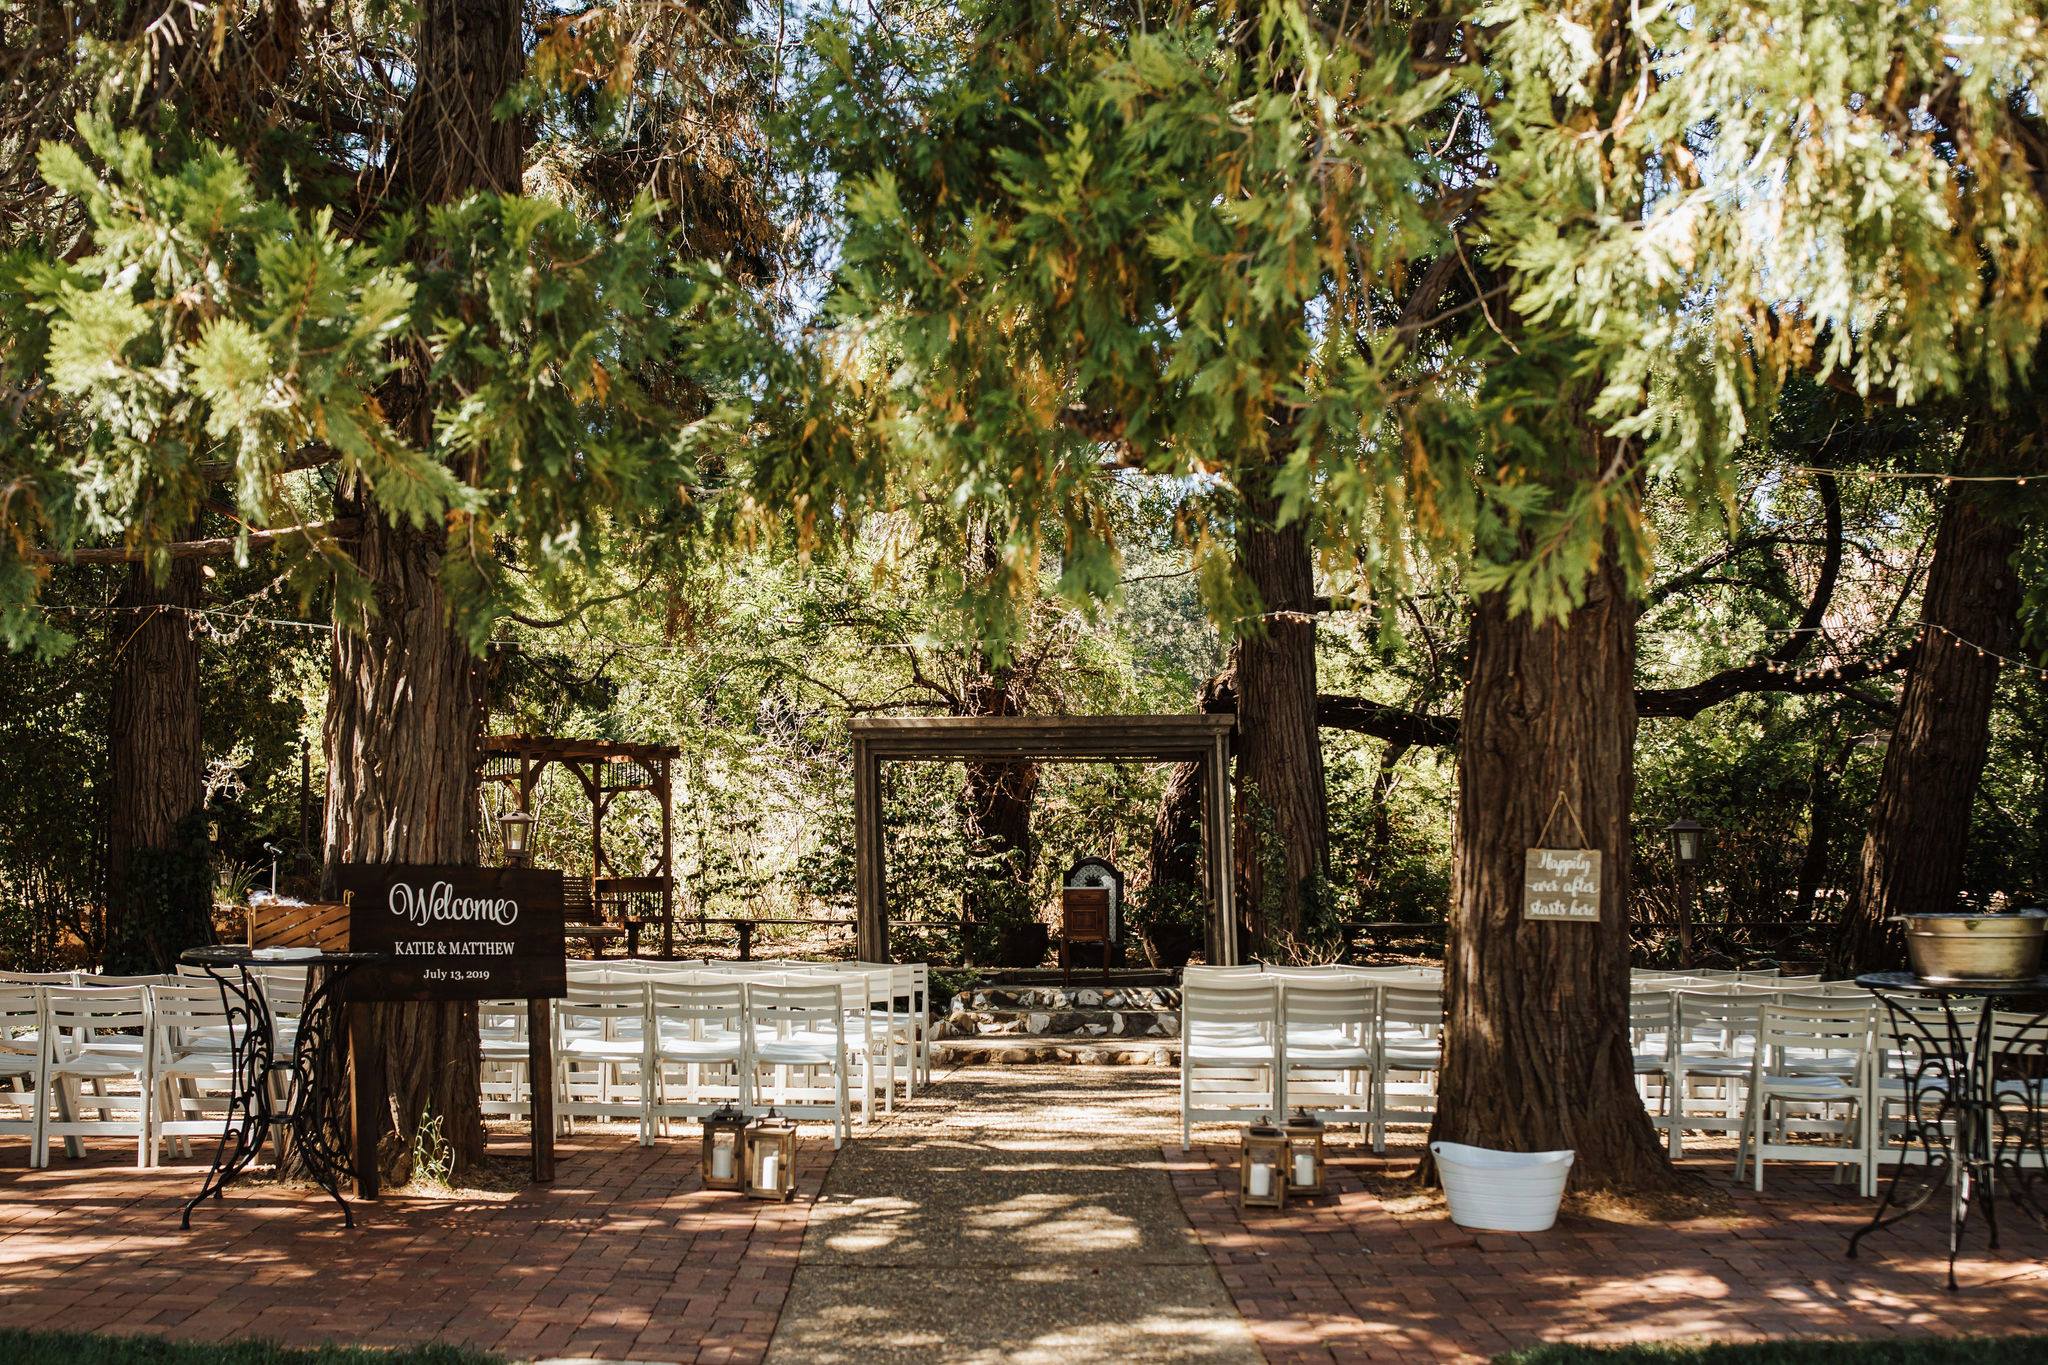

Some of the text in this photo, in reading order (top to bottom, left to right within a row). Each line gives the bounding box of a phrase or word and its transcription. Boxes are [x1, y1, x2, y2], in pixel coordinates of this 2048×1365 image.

[1538, 852, 1591, 877] Happily
[1563, 875, 1600, 897] after
[388, 881, 518, 926] Welcome
[1530, 899, 1596, 915] starts here
[394, 941, 515, 955] KATIE & MATTHEW
[423, 969, 490, 981] July 13, 2019
